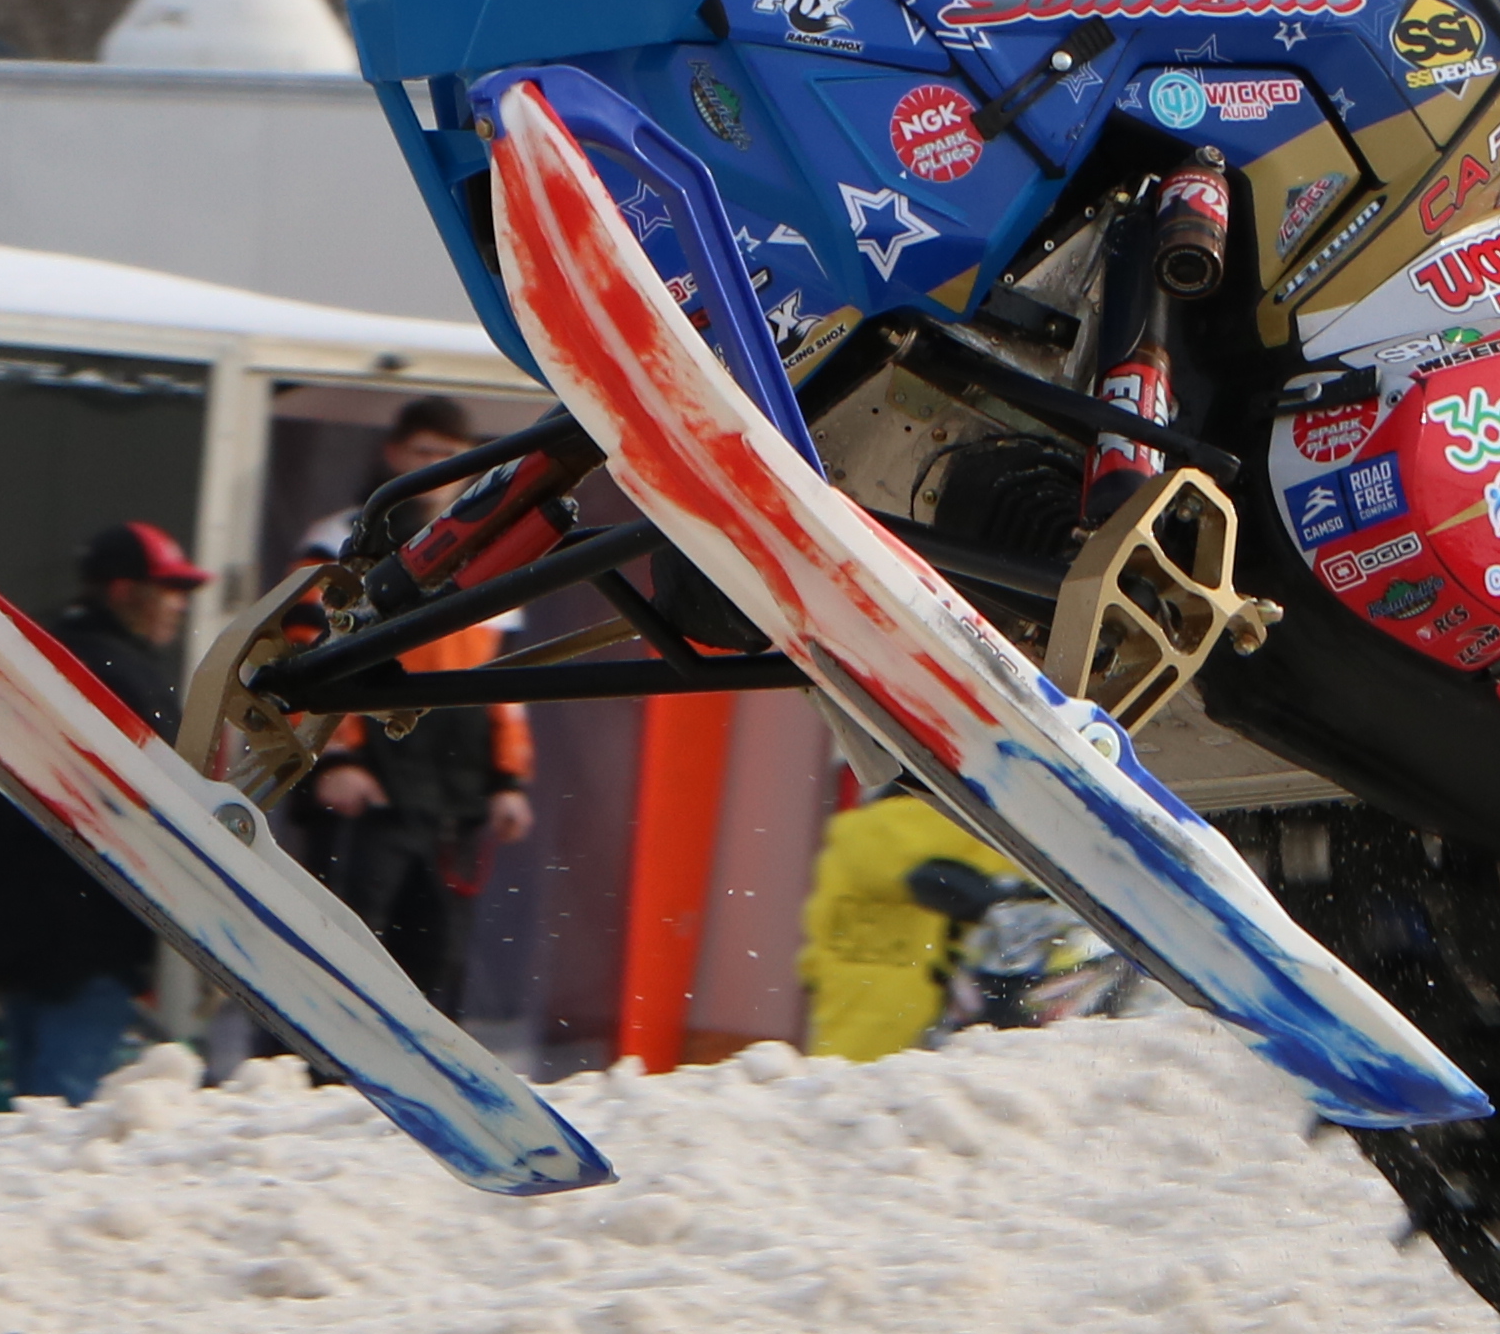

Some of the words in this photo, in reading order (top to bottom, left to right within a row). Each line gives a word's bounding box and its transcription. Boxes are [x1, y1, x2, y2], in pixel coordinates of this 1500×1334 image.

[786, 32, 830, 49] RACING
[831, 37, 864, 53] SHOX
[1203, 78, 1304, 107] WICKED
[899, 101, 964, 142] NGK
[1219, 103, 1270, 121] AUDIO
[911, 129, 970, 160] SPARK
[917, 143, 977, 174] PLUGS
[783, 345, 816, 371] ACING
[816, 323, 847, 349] SHOX
[1305, 431, 1363, 455] PLUGS
[1306, 418, 1363, 439] SPARK
[1349, 460, 1392, 491] ROAD
[1353, 479, 1396, 511] FREE
[1359, 498, 1399, 521] COMPANY
[1302, 515, 1344, 542] CAMSO
[1357, 535, 1422, 573] OGIO
[1434, 604, 1469, 636] RCS
